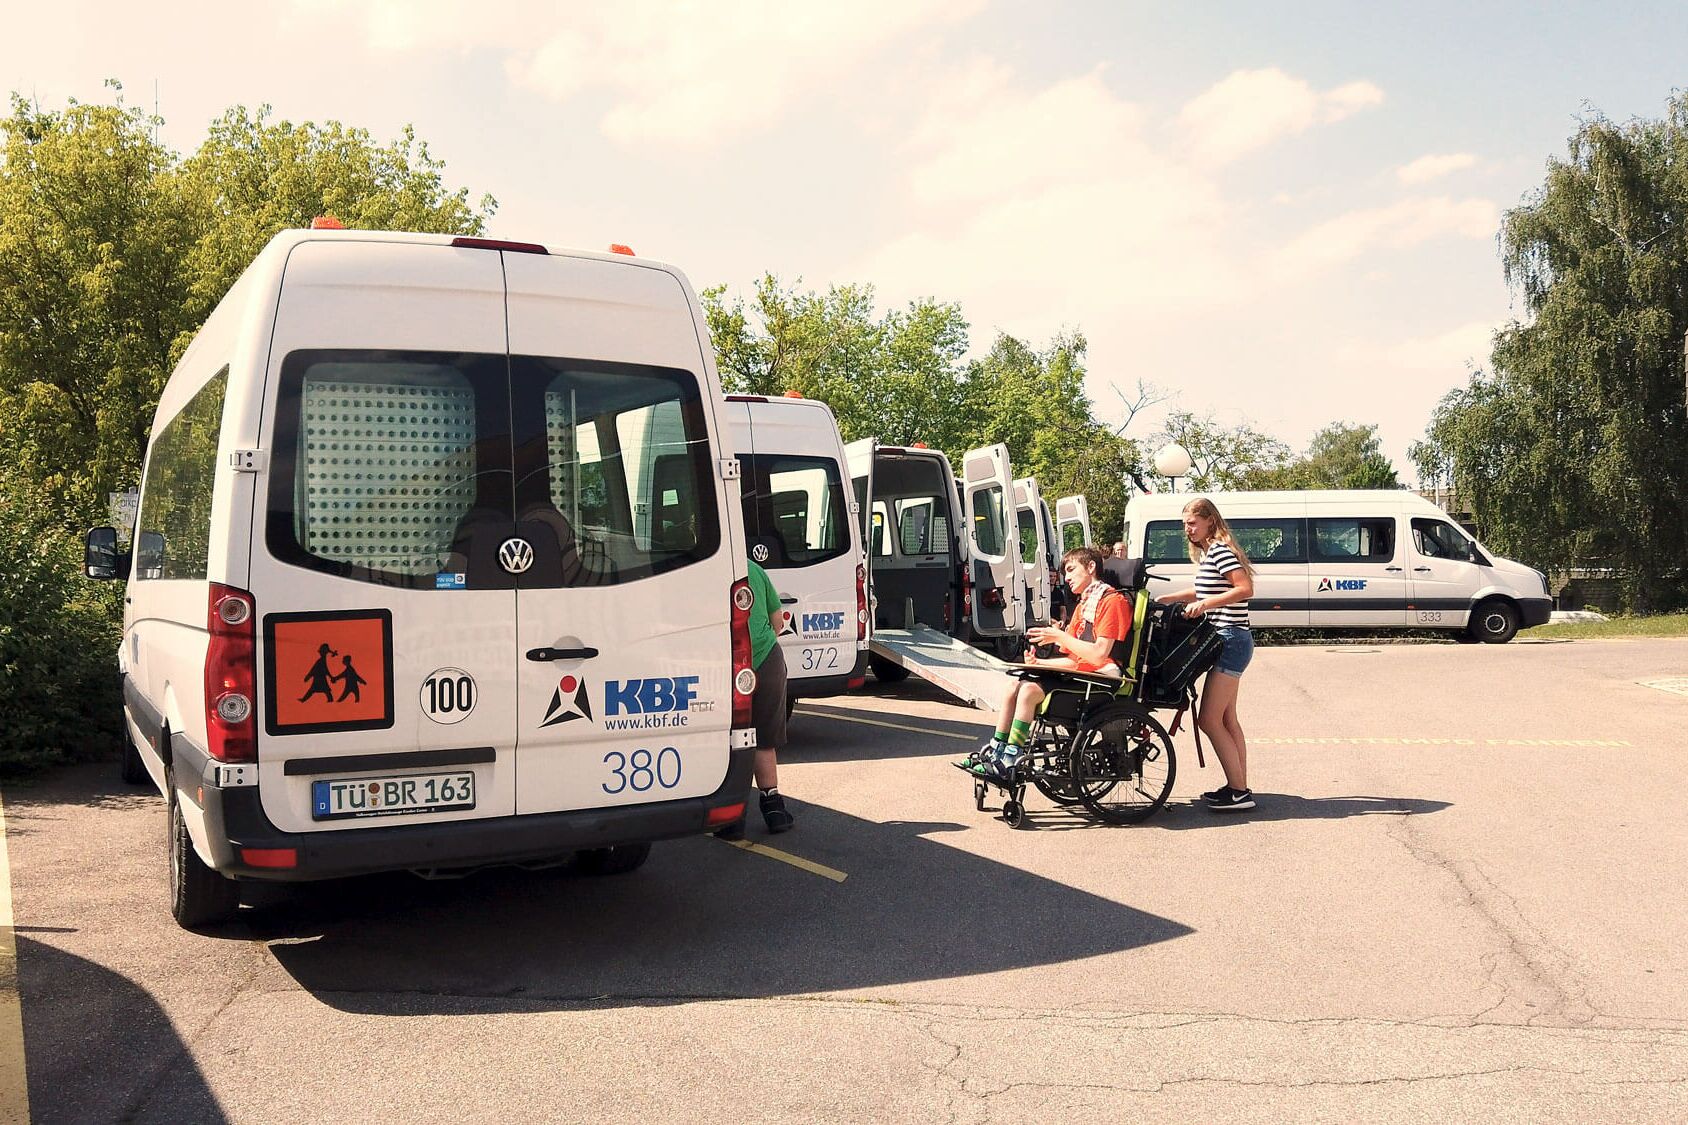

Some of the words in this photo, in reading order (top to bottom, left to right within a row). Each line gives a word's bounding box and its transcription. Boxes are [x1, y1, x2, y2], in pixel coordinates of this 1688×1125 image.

[499, 538, 534, 574] VW
[1335, 579, 1367, 591] KBF
[802, 612, 845, 632] KBF
[1420, 611, 1442, 623] 333
[803, 631, 841, 640] www.kbf.de
[802, 647, 838, 670] 372
[425, 676, 473, 713] 100
[604, 675, 699, 716] KBF
[604, 712, 688, 730] www.kbf.de
[601, 746, 682, 794] 380
[384, 780, 418, 806] BR
[424, 777, 471, 803] 163
